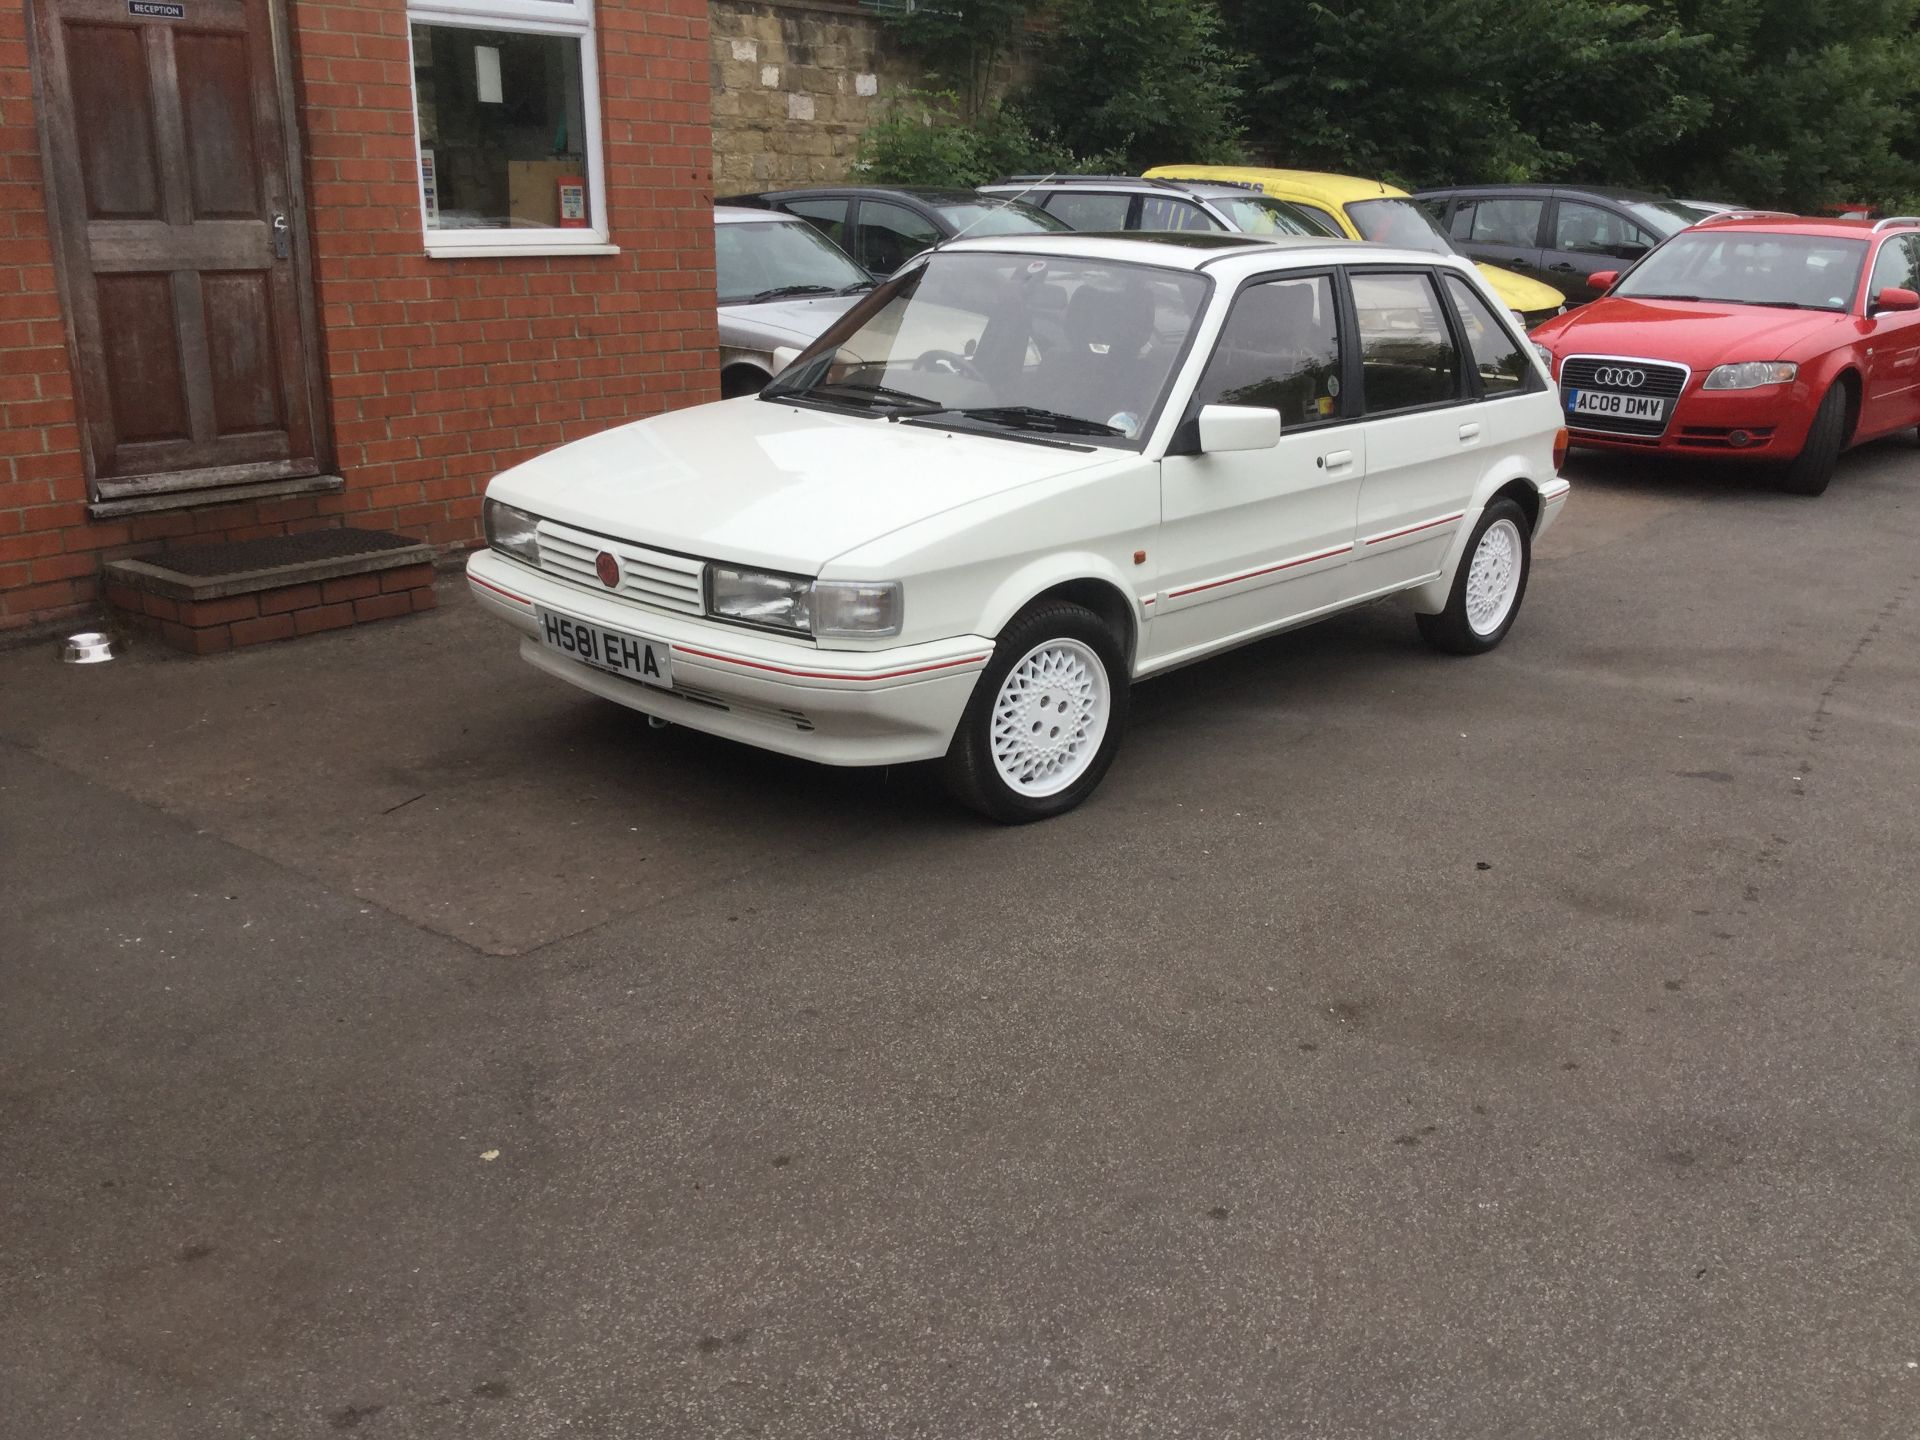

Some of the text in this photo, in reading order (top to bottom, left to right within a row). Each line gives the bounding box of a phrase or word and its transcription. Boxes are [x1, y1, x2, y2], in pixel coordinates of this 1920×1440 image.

[134, 4, 179, 15] RECEPTION
[1578, 393, 1660, 416] AC08 DMV
[544, 613, 660, 678] H581 EHA
